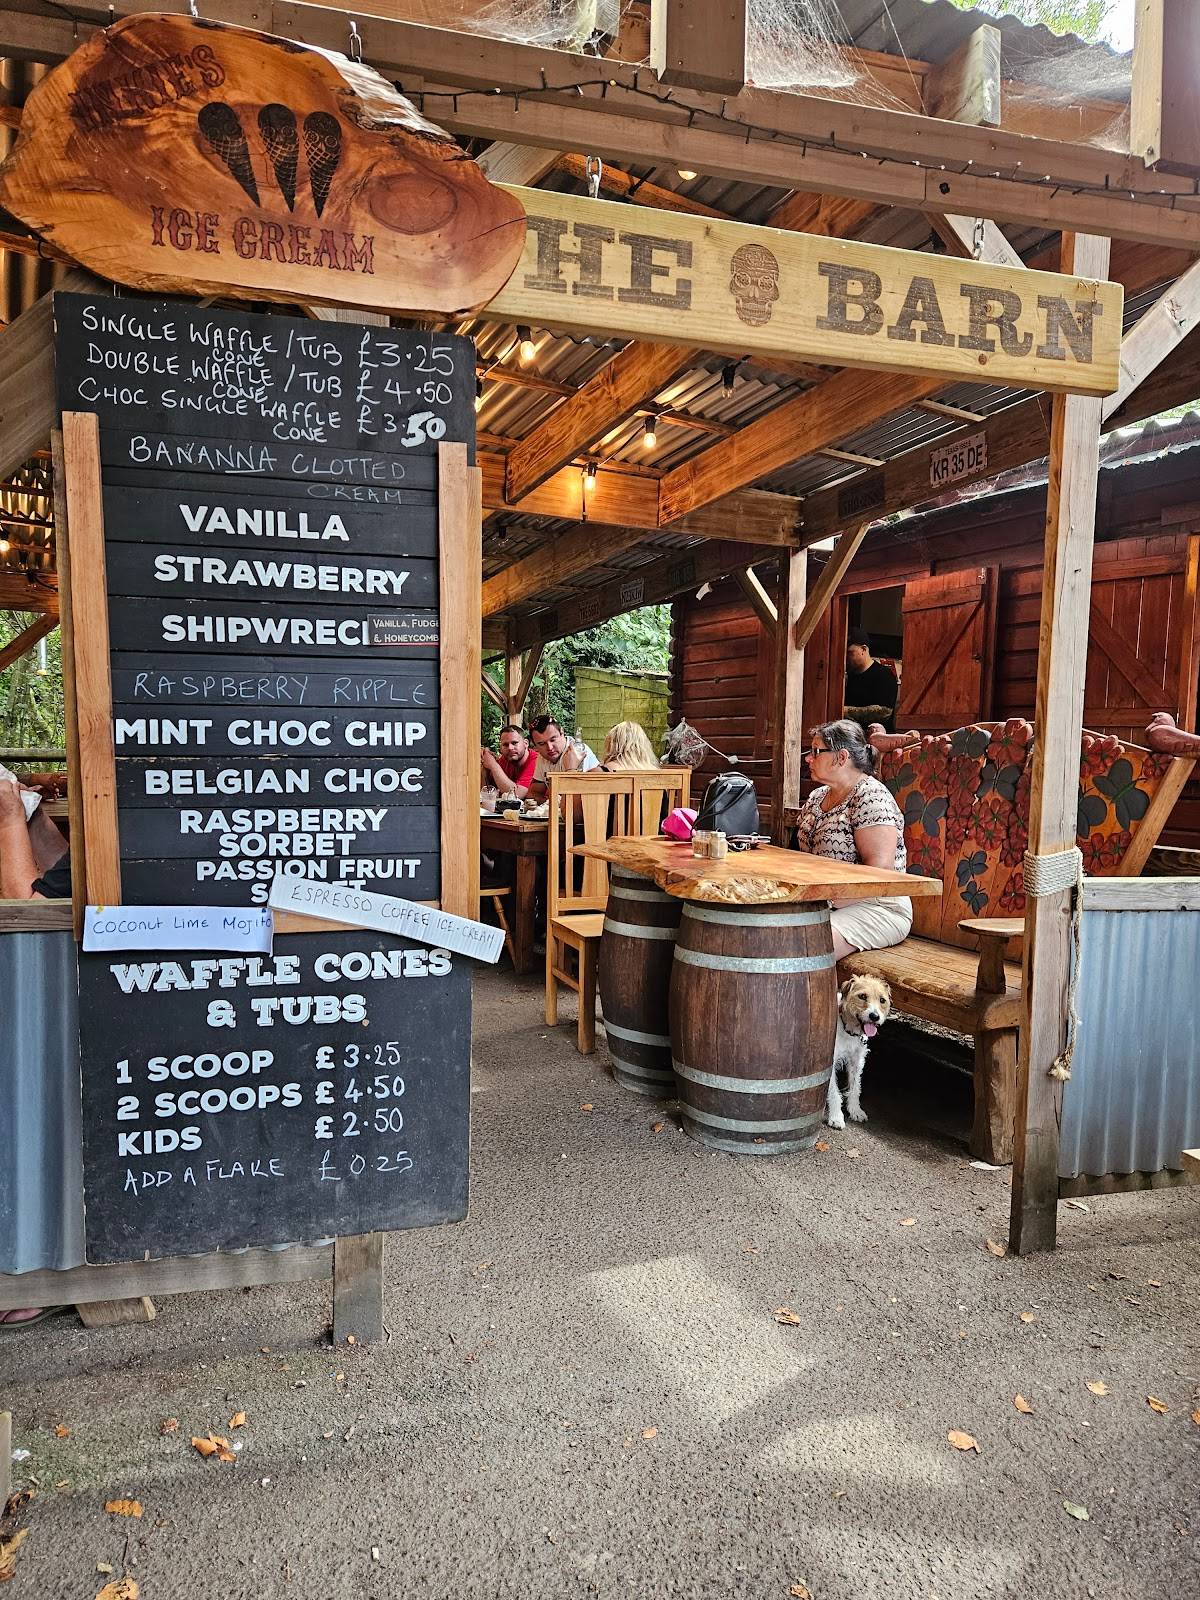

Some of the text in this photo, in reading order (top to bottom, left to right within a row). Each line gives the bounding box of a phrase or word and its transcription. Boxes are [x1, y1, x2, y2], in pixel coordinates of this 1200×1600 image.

[151, 204, 375, 275] ICE CREAM
[82, 306, 177, 341] SINGLE
[189, 322, 278, 353] WAFFLE
[816, 261, 1104, 364] BARN
[86, 342, 179, 375] DOUBLE
[192, 356, 274, 387] WAFFLE
[212, 348, 266, 368] CONE
[78, 377, 149, 405] CHOC
[160, 389, 248, 416] SINGLE
[260, 401, 341, 428] WAFFLE
[213, 381, 268, 404] CONE
[273, 422, 327, 443] CONE
[128, 436, 405, 480] BANANNA CLOTTED
[933, 443, 983, 481] KR 35 DE
[307, 484, 402, 504] CREAM
[179, 504, 350, 541] VANILLA
[153, 554, 410, 595] STRAWBERRY
[374, 633, 439, 643] & HONEYCOMB
[134, 672, 428, 705] RASPBERRY RIPPLE
[115, 718, 427, 747] MINT CHOC CHIP
[145, 767, 424, 795] BELGIAN CHOC
[180, 808, 388, 834] RASPBERRY
[218, 832, 356, 858] SORBET
[196, 858, 421, 882] PASSION FRUIT
[291, 885, 372, 912] ESPRESSO
[381, 902, 430, 926] COFFEE
[174, 917, 209, 929] Lime
[223, 917, 271, 935] Mojito
[109, 949, 452, 994] WAFFLE CONES
[206, 994, 368, 1028] & TUBS
[116, 1059, 132, 1084] 1
[147, 1050, 274, 1082] SCOOP
[116, 1096, 139, 1120] 2
[154, 1083, 302, 1118] SCOOPS
[118, 1127, 202, 1157] KIDS
[123, 1169, 172, 1196] ADD
[183, 1167, 197, 1186] A
[206, 1158, 284, 1182] FLAKE
